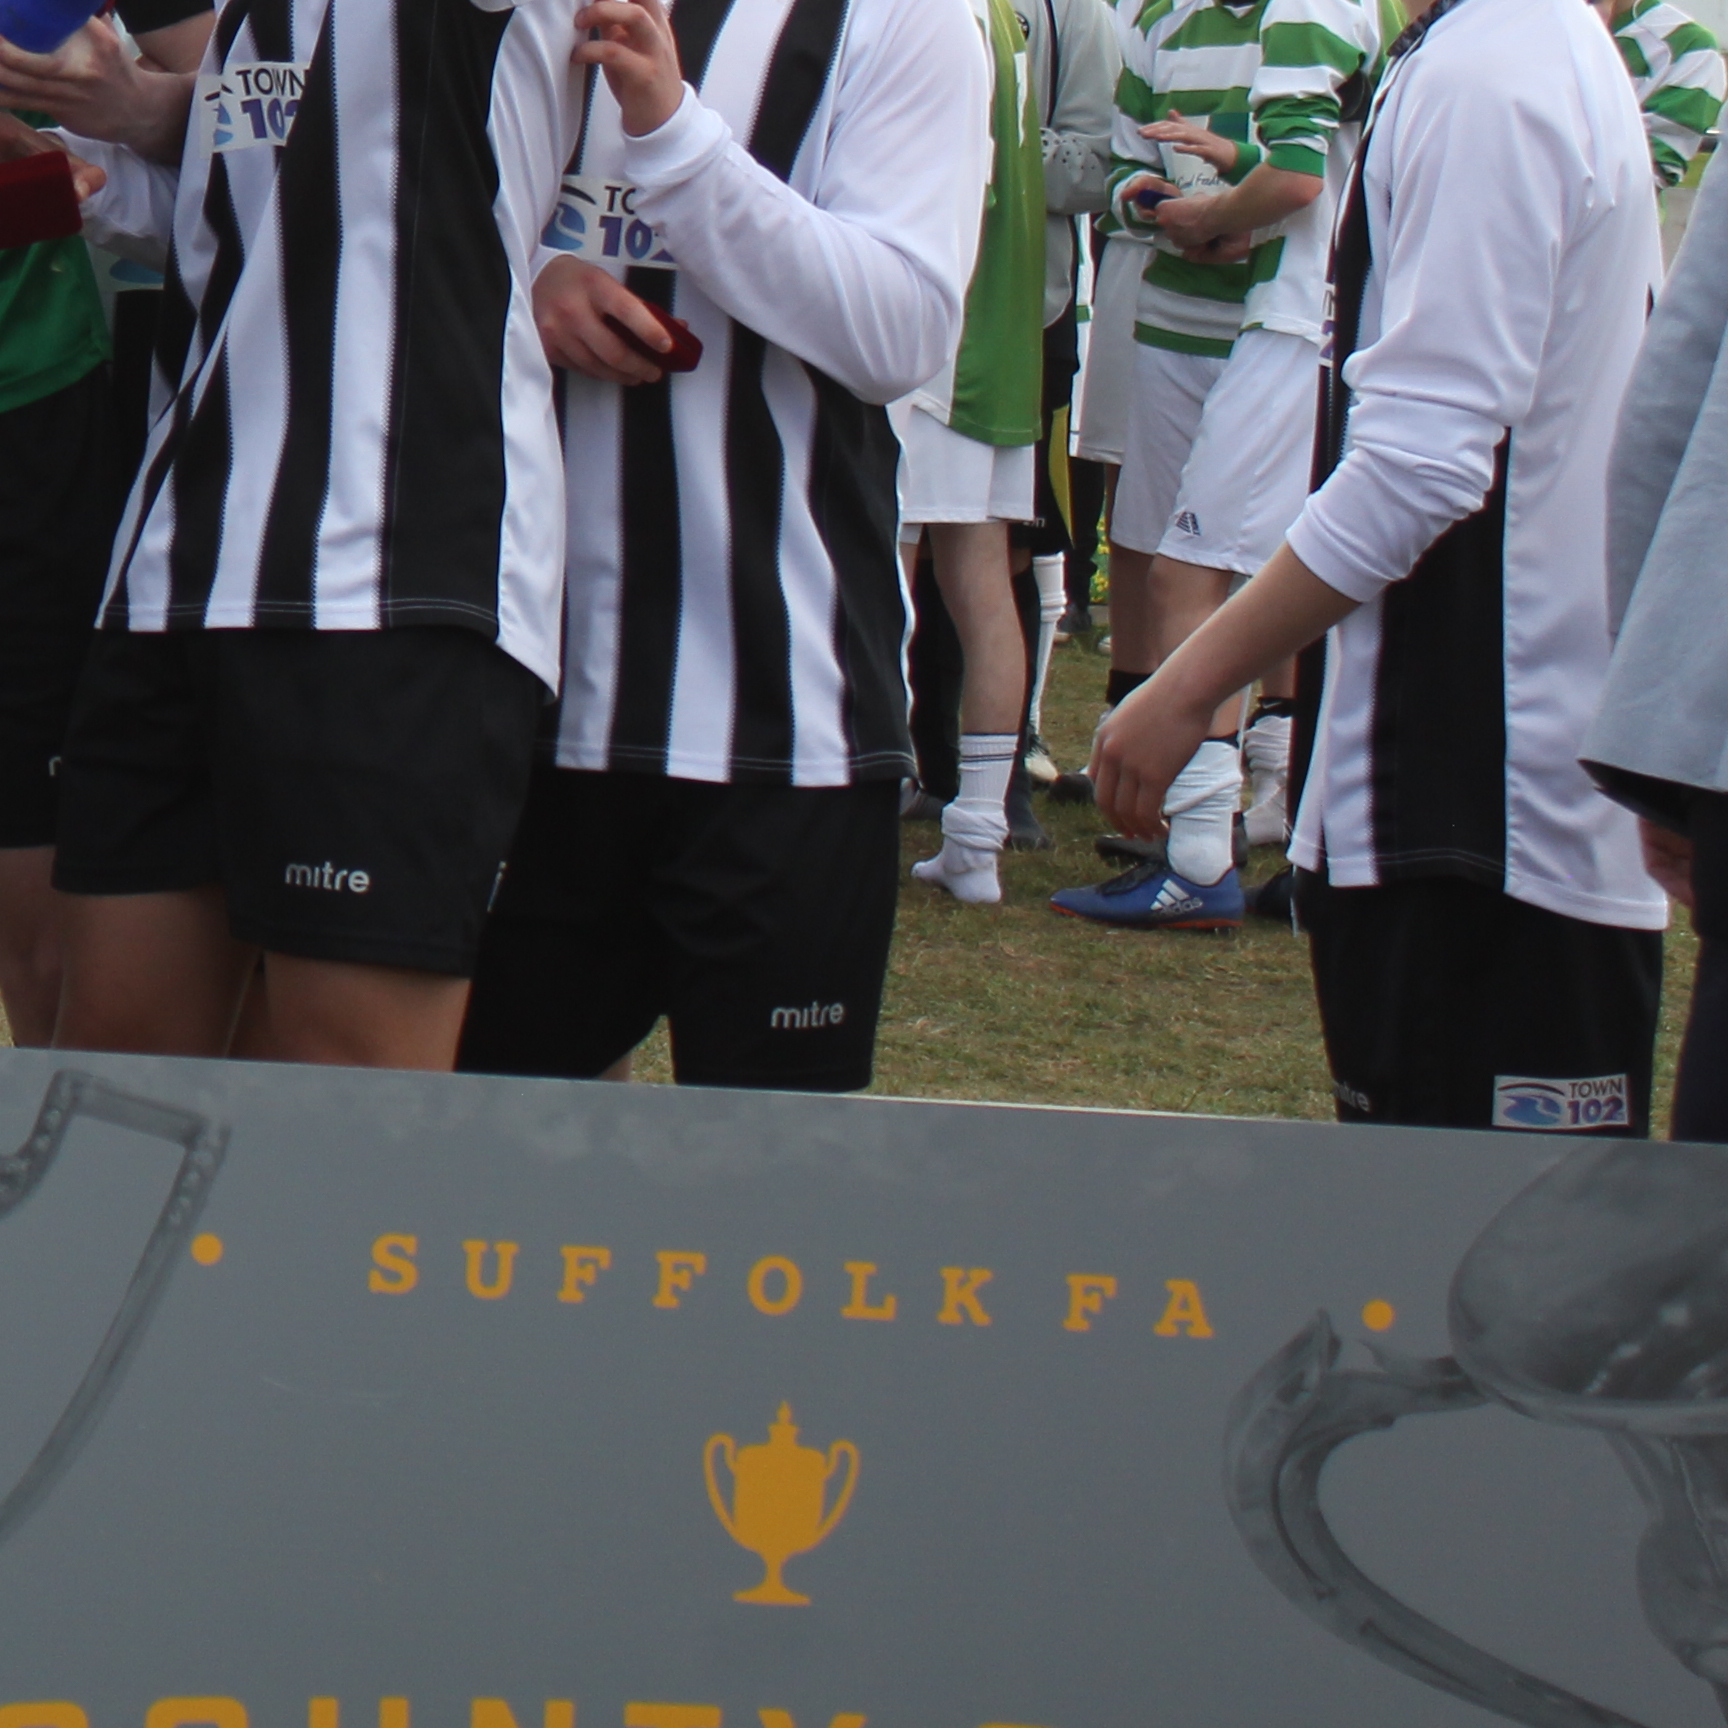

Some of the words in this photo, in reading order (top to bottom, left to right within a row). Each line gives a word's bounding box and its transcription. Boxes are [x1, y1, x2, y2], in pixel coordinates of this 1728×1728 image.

[285, 860, 371, 894] mitre
[769, 1000, 846, 1030] mitre
[1568, 1079, 1623, 1098] TOWN
[1567, 1097, 1625, 1125] 102
[367, 1232, 993, 1326] SUFFOLK
[1060, 1272, 1214, 1338] FA
